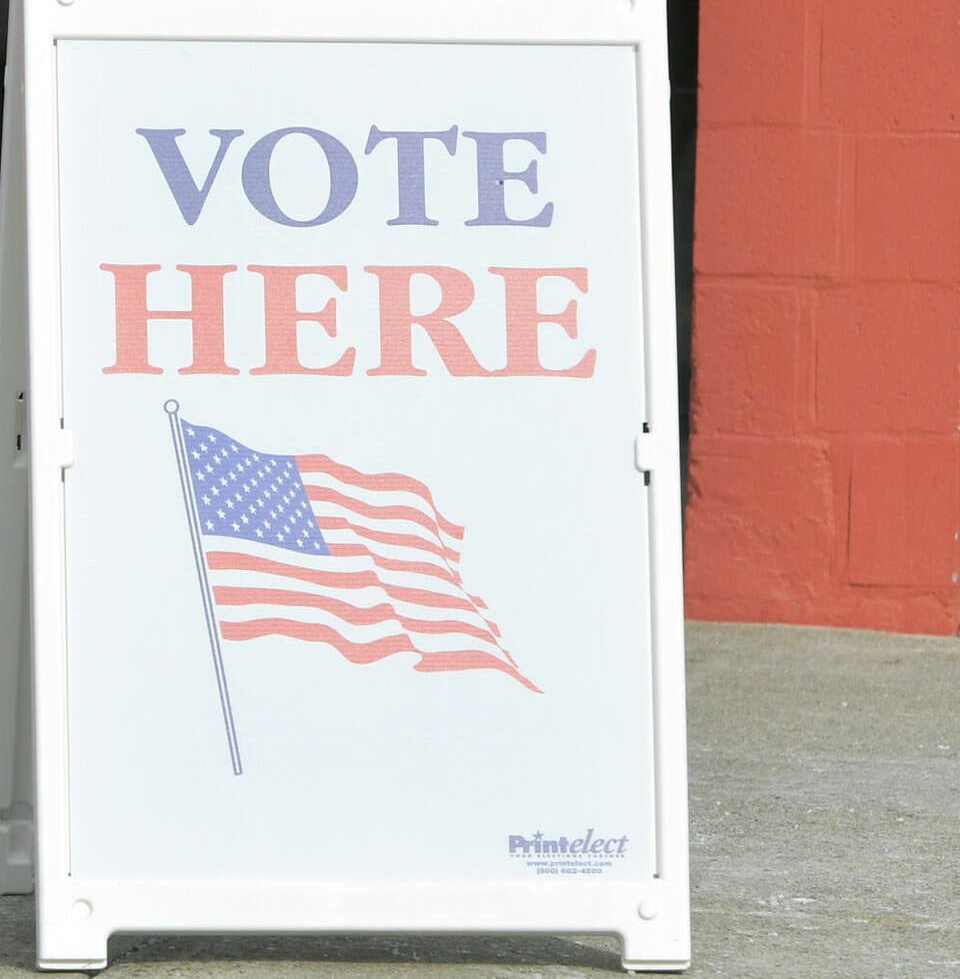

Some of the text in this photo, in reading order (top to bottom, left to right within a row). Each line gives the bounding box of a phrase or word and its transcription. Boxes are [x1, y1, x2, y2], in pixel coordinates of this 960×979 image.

[136, 125, 555, 229] VOTE
[100, 263, 597, 378] HERE
[508, 828, 629, 854] Printelect
